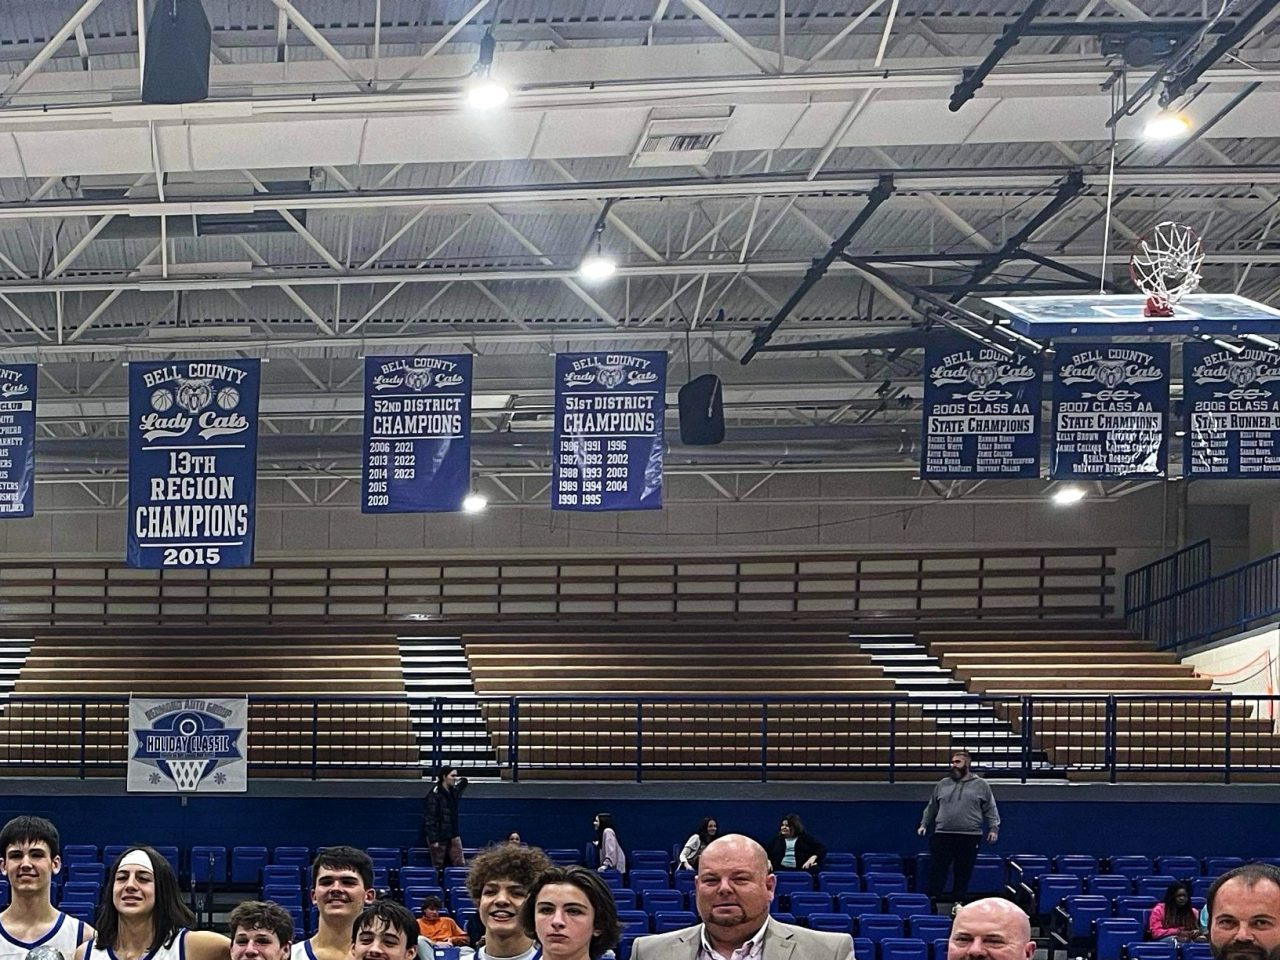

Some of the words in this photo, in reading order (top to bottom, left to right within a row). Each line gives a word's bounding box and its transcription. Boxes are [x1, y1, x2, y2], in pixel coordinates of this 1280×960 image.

[572, 357, 600, 370] BELL
[606, 355, 651, 369] COUNTY
[943, 351, 974, 367] BELL
[1072, 349, 1103, 366] BELL
[1108, 349, 1153, 365] COUNTY
[1203, 351, 1232, 366] BELL
[381, 360, 409, 374] BELL
[414, 358, 457, 372] COUNTY
[143, 366, 182, 388] BELL
[188, 363, 248, 385] COUNTY
[374, 399, 400, 412] 52ND
[403, 399, 461, 412] DISTRICT
[566, 397, 592, 410] 51ST
[594, 396, 653, 410] DISTRICT
[933, 404, 964, 414] 2005
[968, 404, 1009, 414] CLASS
[1013, 404, 1030, 414] AA
[1060, 402, 1089, 412] 2007
[1093, 402, 1132, 412] CLASS
[1137, 402, 1153, 412] AA
[1195, 401, 1226, 411] 2006
[1230, 401, 1268, 411] CLASS
[139, 413, 193, 437] Lady
[198, 411, 249, 436] Cats
[373, 415, 461, 434] CHAMPIONS
[563, 413, 655, 432] CHAMPIONS
[932, 418, 964, 432] STATE
[968, 417, 1030, 432] CHAMPIONS
[1061, 414, 1094, 429] STATE
[1097, 414, 1158, 429] CHAMPIONS
[370, 442, 390, 453] 2006
[394, 442, 414, 453] 2021
[560, 440, 579, 452] 1986
[584, 440, 601, 452] 1991
[607, 440, 627, 452] 1996
[170, 452, 216, 474] 13TH
[369, 456, 388, 466] 2013
[394, 456, 415, 466] 2022
[560, 454, 579, 465] 1987
[583, 454, 602, 465] 1992
[607, 454, 628, 465] 2002
[369, 469, 388, 479] 2014
[394, 469, 415, 479] 2023
[150, 477, 235, 500] REGION
[368, 482, 387, 492] 2015
[368, 495, 389, 506] 2020
[136, 505, 248, 538] CHAMPIONS
[164, 548, 220, 565] 2015
[146, 736, 190, 753] HOLIDAY
[190, 735, 229, 752] CLASSIC
